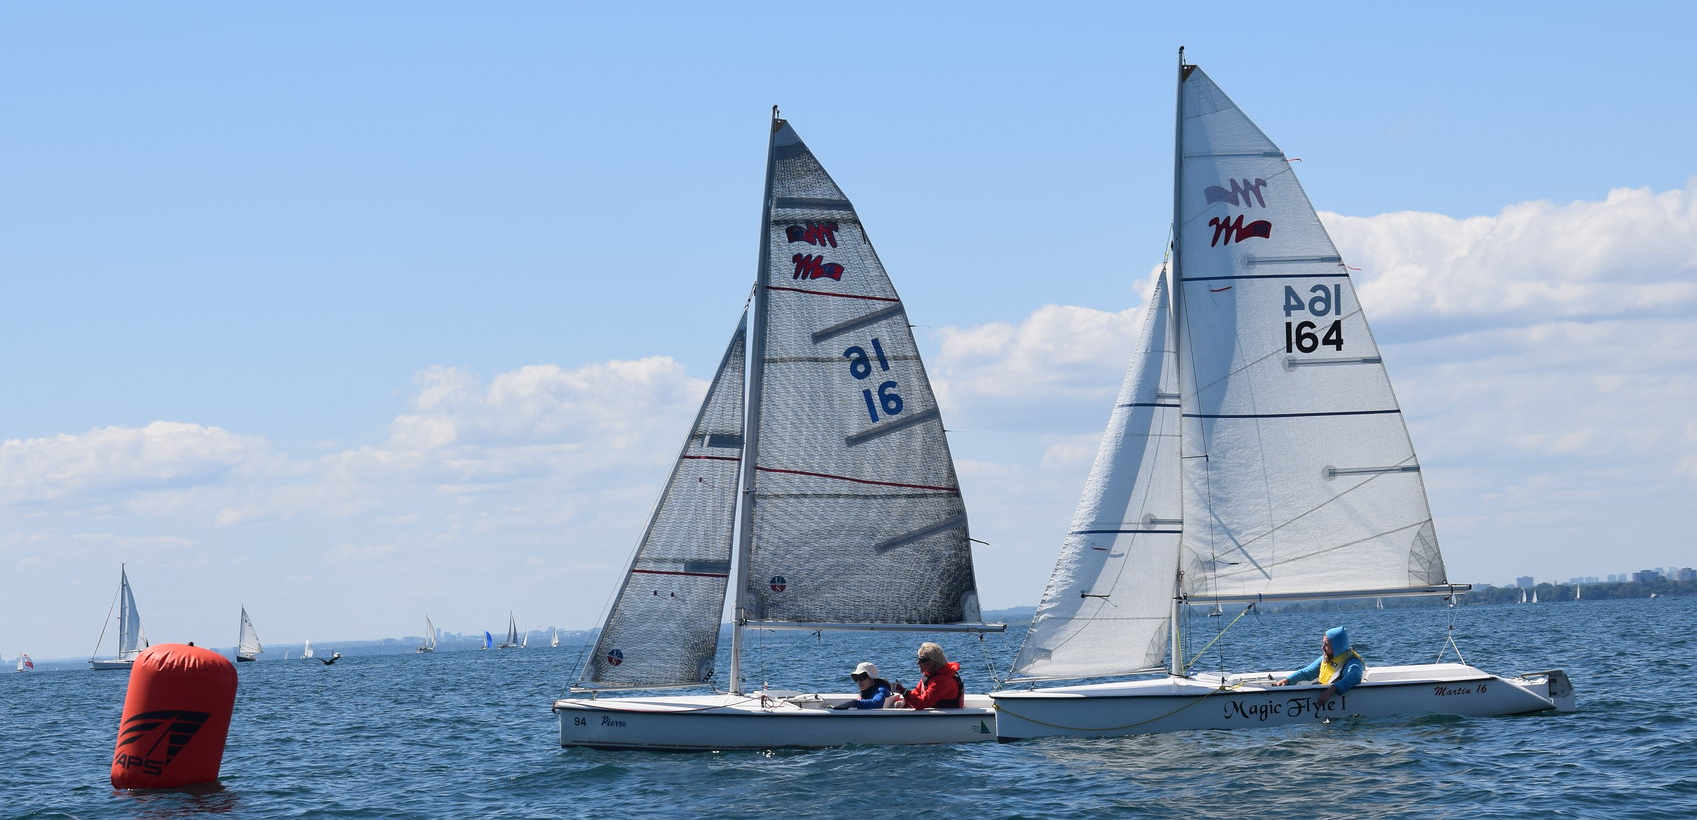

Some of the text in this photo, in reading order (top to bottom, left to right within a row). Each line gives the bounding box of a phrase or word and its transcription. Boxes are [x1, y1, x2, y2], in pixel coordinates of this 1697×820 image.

[1285, 319, 1344, 353] 164
[862, 380, 904, 423] 16
[1434, 684, 1487, 696] Martin 16
[1224, 700, 1282, 721] Magic
[574, 715, 627, 728] 94 Pierre
[115, 753, 163, 775] APS
